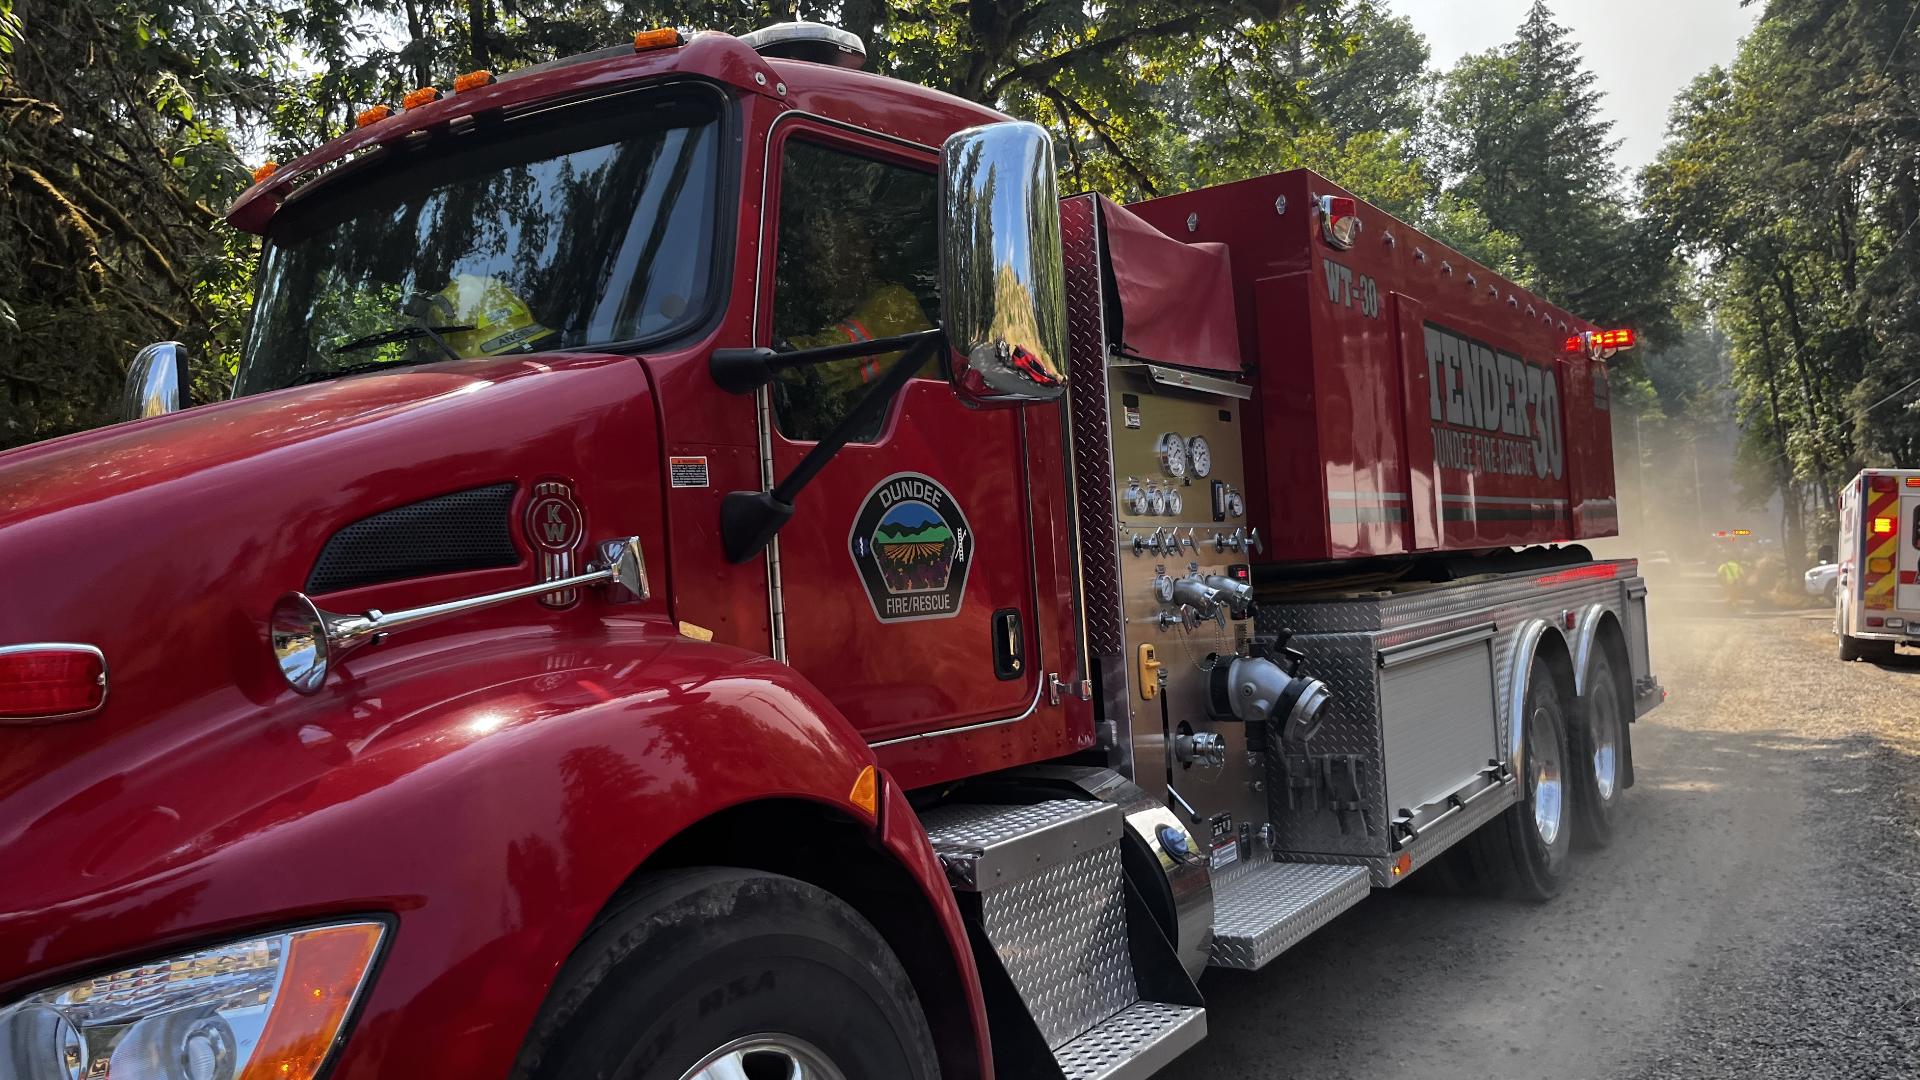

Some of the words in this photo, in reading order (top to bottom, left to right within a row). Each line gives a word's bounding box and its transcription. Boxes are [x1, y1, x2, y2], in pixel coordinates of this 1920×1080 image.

[1323, 258, 1378, 318] WT-30
[1423, 322, 1531, 438] TENDER
[1526, 365, 1563, 481] 30
[1430, 427, 1474, 472] DUNDEE
[878, 480, 943, 508] DUNDEE
[886, 593, 951, 614] FIRE/RESCUE
